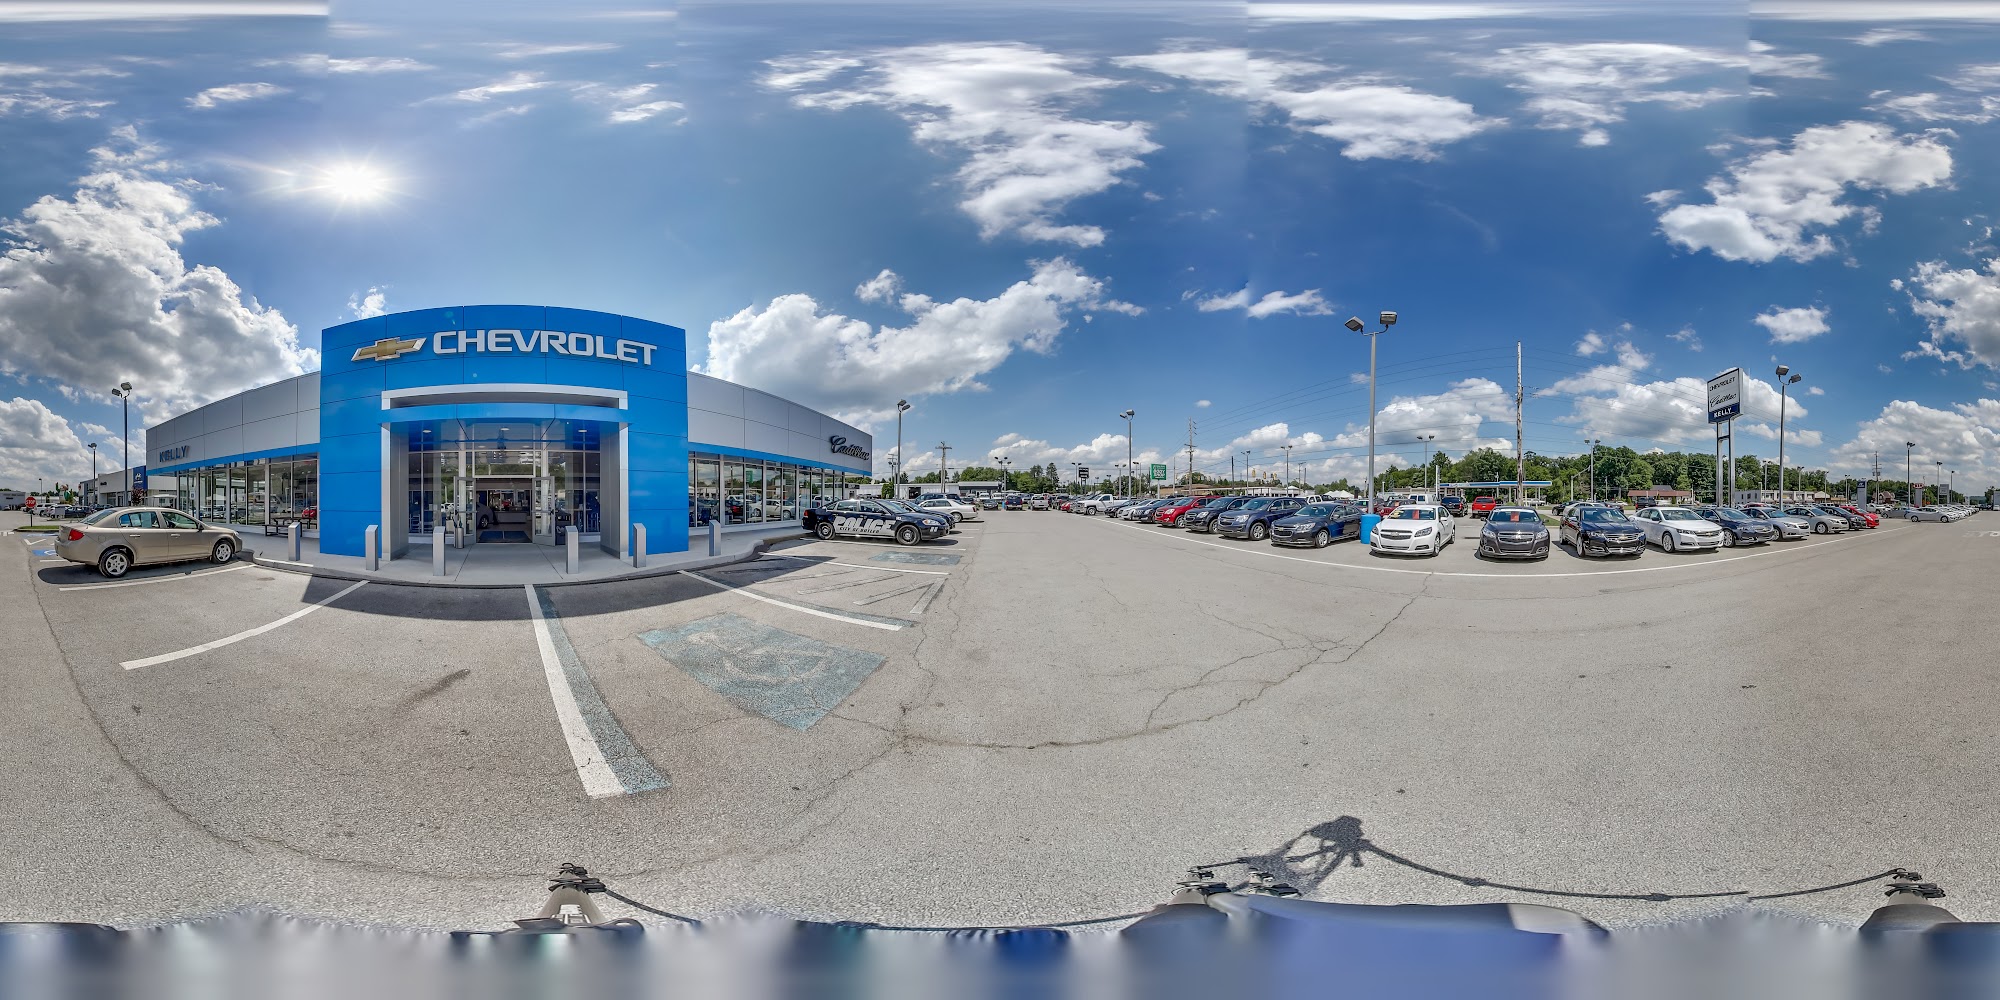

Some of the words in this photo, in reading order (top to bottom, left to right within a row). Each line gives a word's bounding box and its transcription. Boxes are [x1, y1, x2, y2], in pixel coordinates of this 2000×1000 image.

[433, 329, 657, 366] CHEVROLET
[1710, 376, 1736, 391] CHEVROLET
[1709, 394, 1737, 408] Cadillac
[1713, 407, 1732, 418] KELLY
[159, 445, 187, 463] KELLY
[830, 435, 870, 461] Cadillac
[833, 515, 896, 531] POLICE
